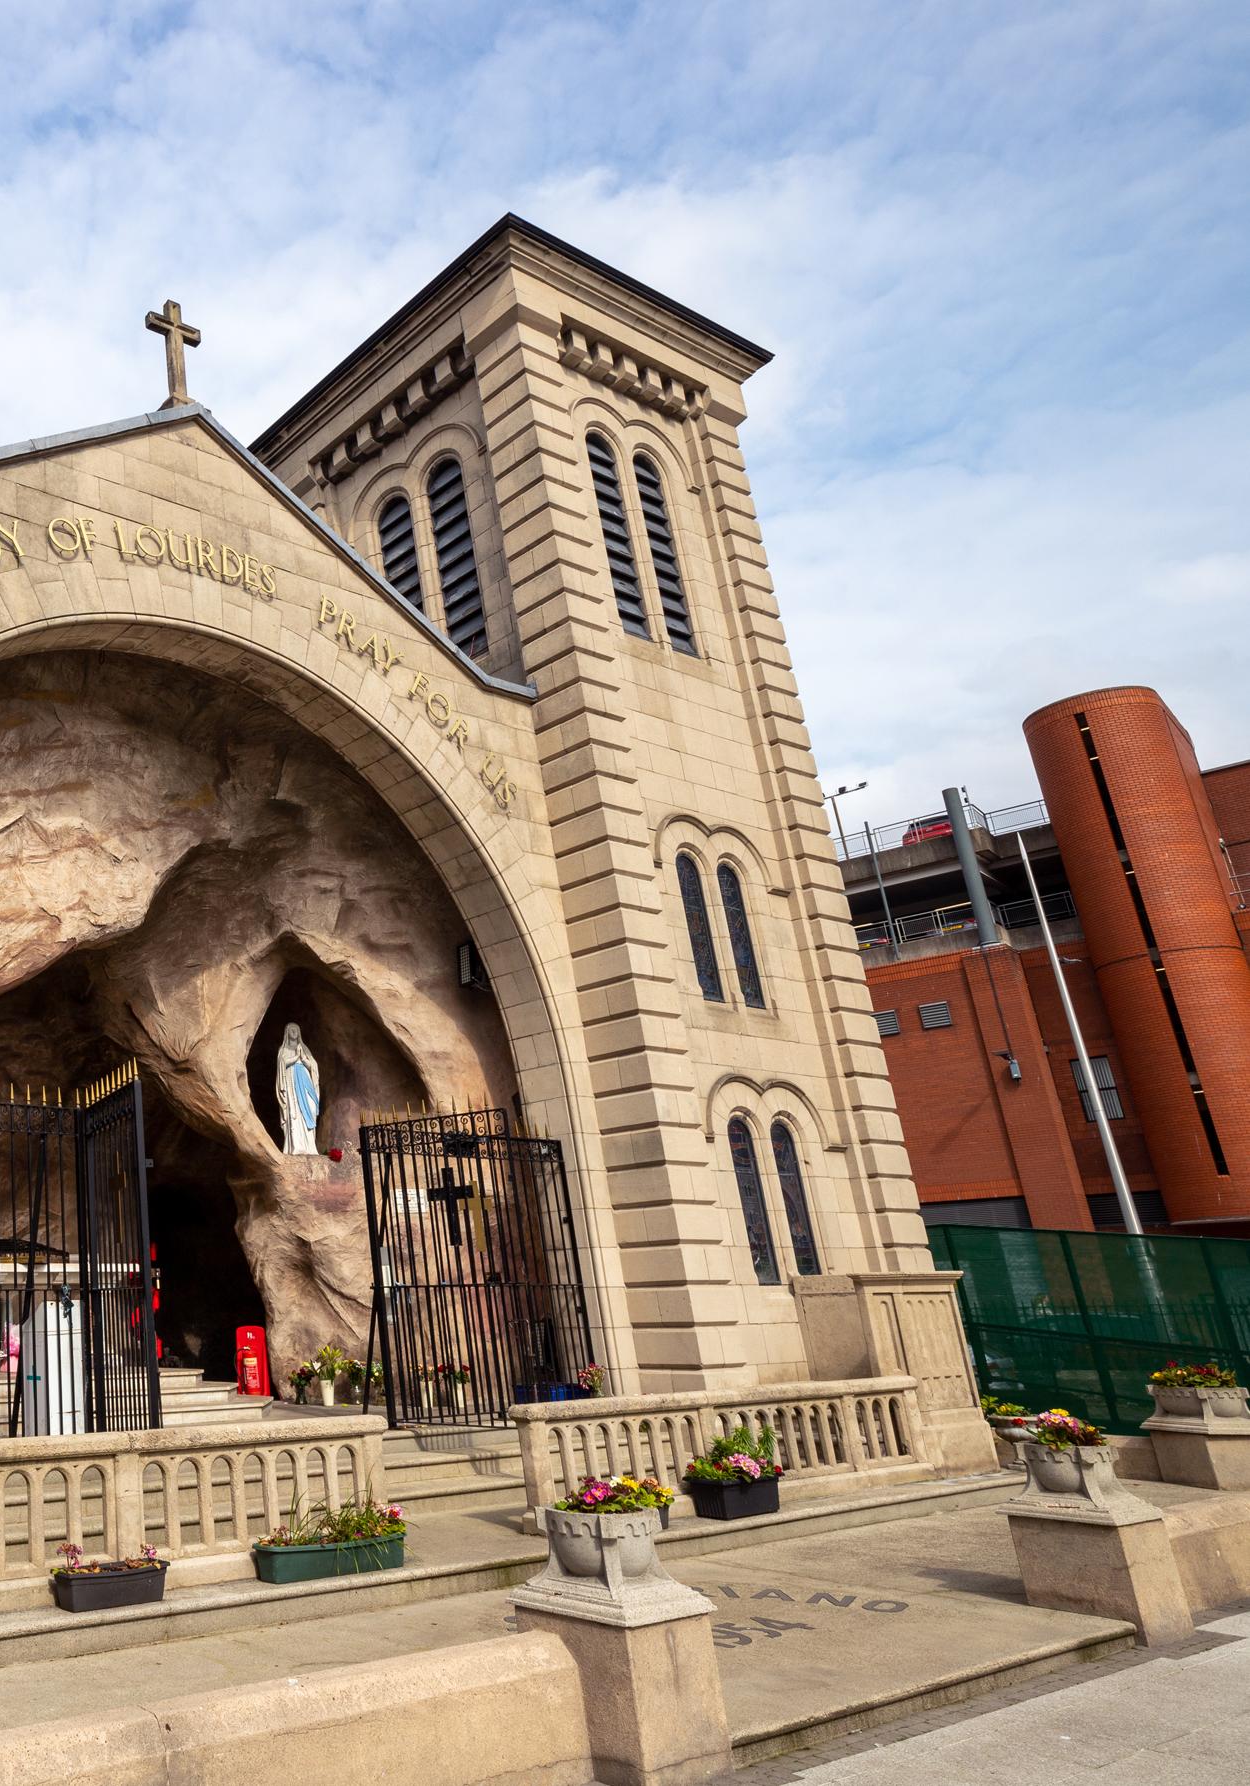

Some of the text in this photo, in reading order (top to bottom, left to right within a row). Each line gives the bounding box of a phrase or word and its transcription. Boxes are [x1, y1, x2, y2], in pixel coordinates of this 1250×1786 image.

[47, 517, 97, 552] OF
[112, 519, 278, 595] LOURDES
[317, 594, 405, 673] PRAY
[408, 671, 471, 750] FOR
[481, 752, 518, 804] US
